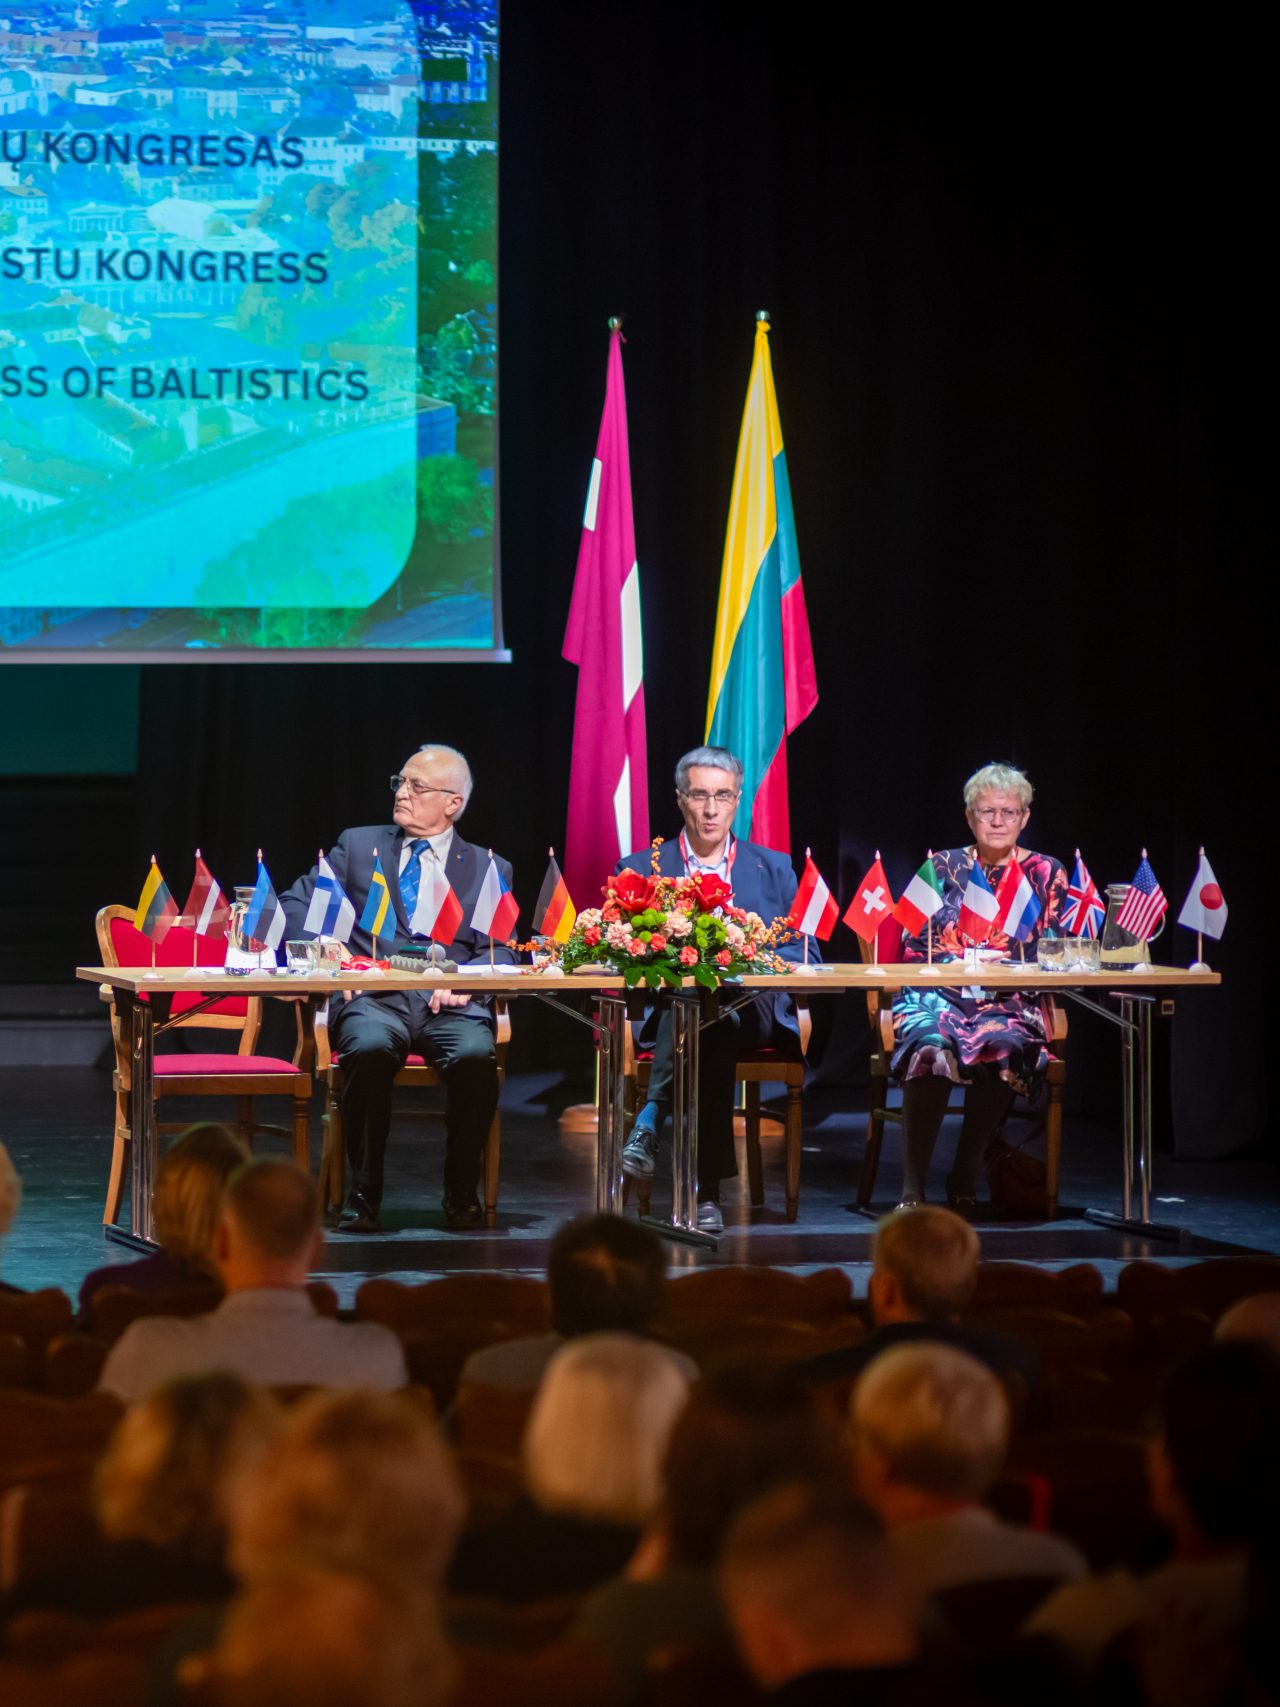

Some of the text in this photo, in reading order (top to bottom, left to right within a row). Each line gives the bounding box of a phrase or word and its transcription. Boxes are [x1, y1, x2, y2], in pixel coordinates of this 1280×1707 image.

[44, 132, 304, 169] KONGRESAS
[97, 249, 329, 284] KONGRESS
[63, 367, 117, 399] OF
[131, 368, 369, 401] BALTISTICS
